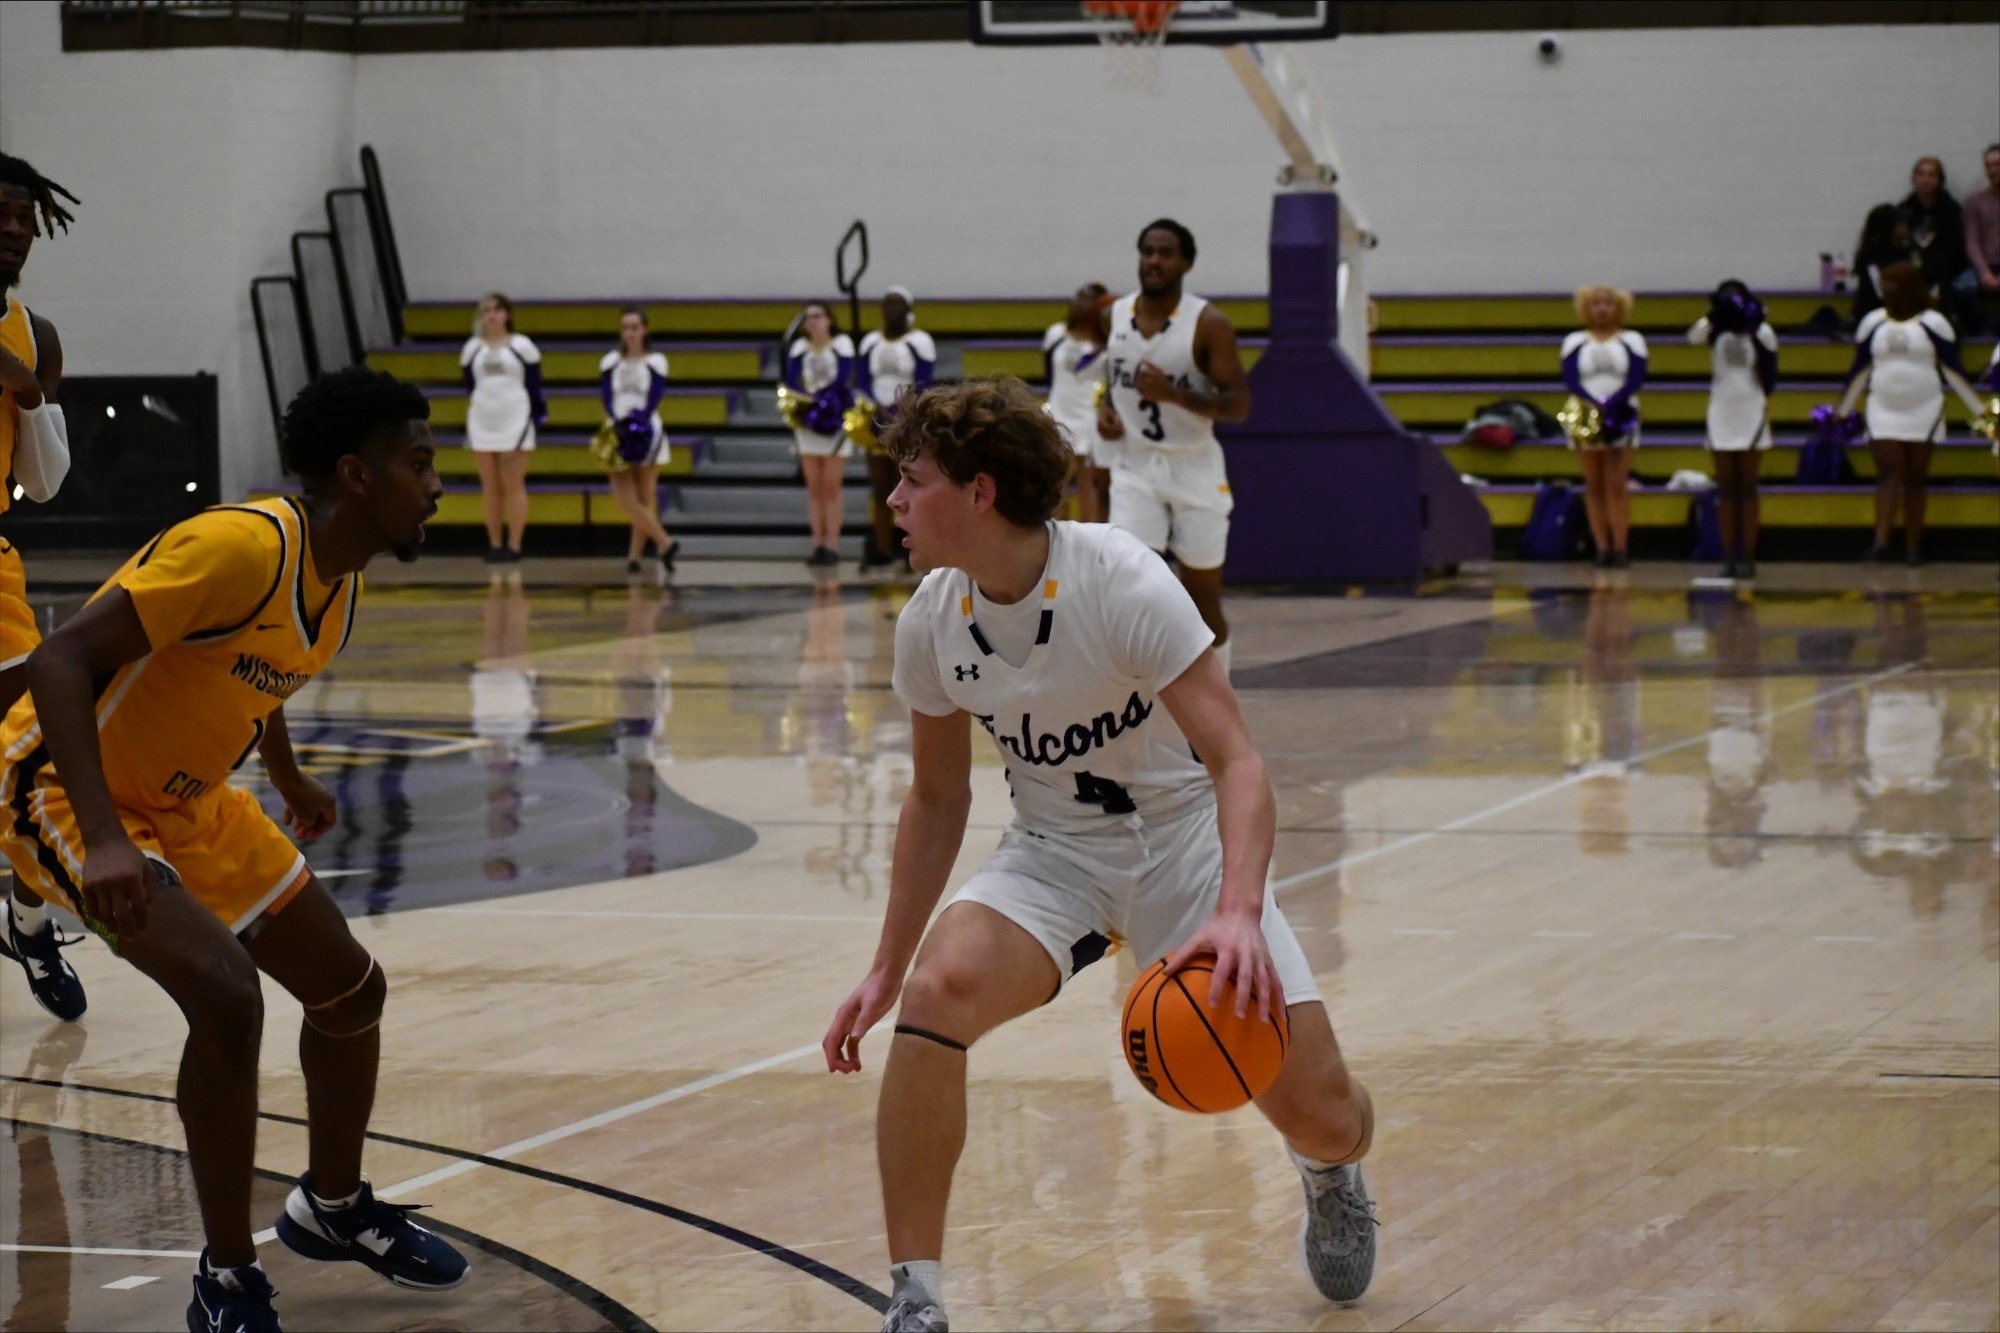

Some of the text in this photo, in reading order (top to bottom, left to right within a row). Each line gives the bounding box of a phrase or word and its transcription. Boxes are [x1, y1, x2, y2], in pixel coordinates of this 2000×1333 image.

[1110, 357, 1193, 390] Fals
[1138, 398, 1165, 442] 3
[1074, 770, 1137, 814] 4
